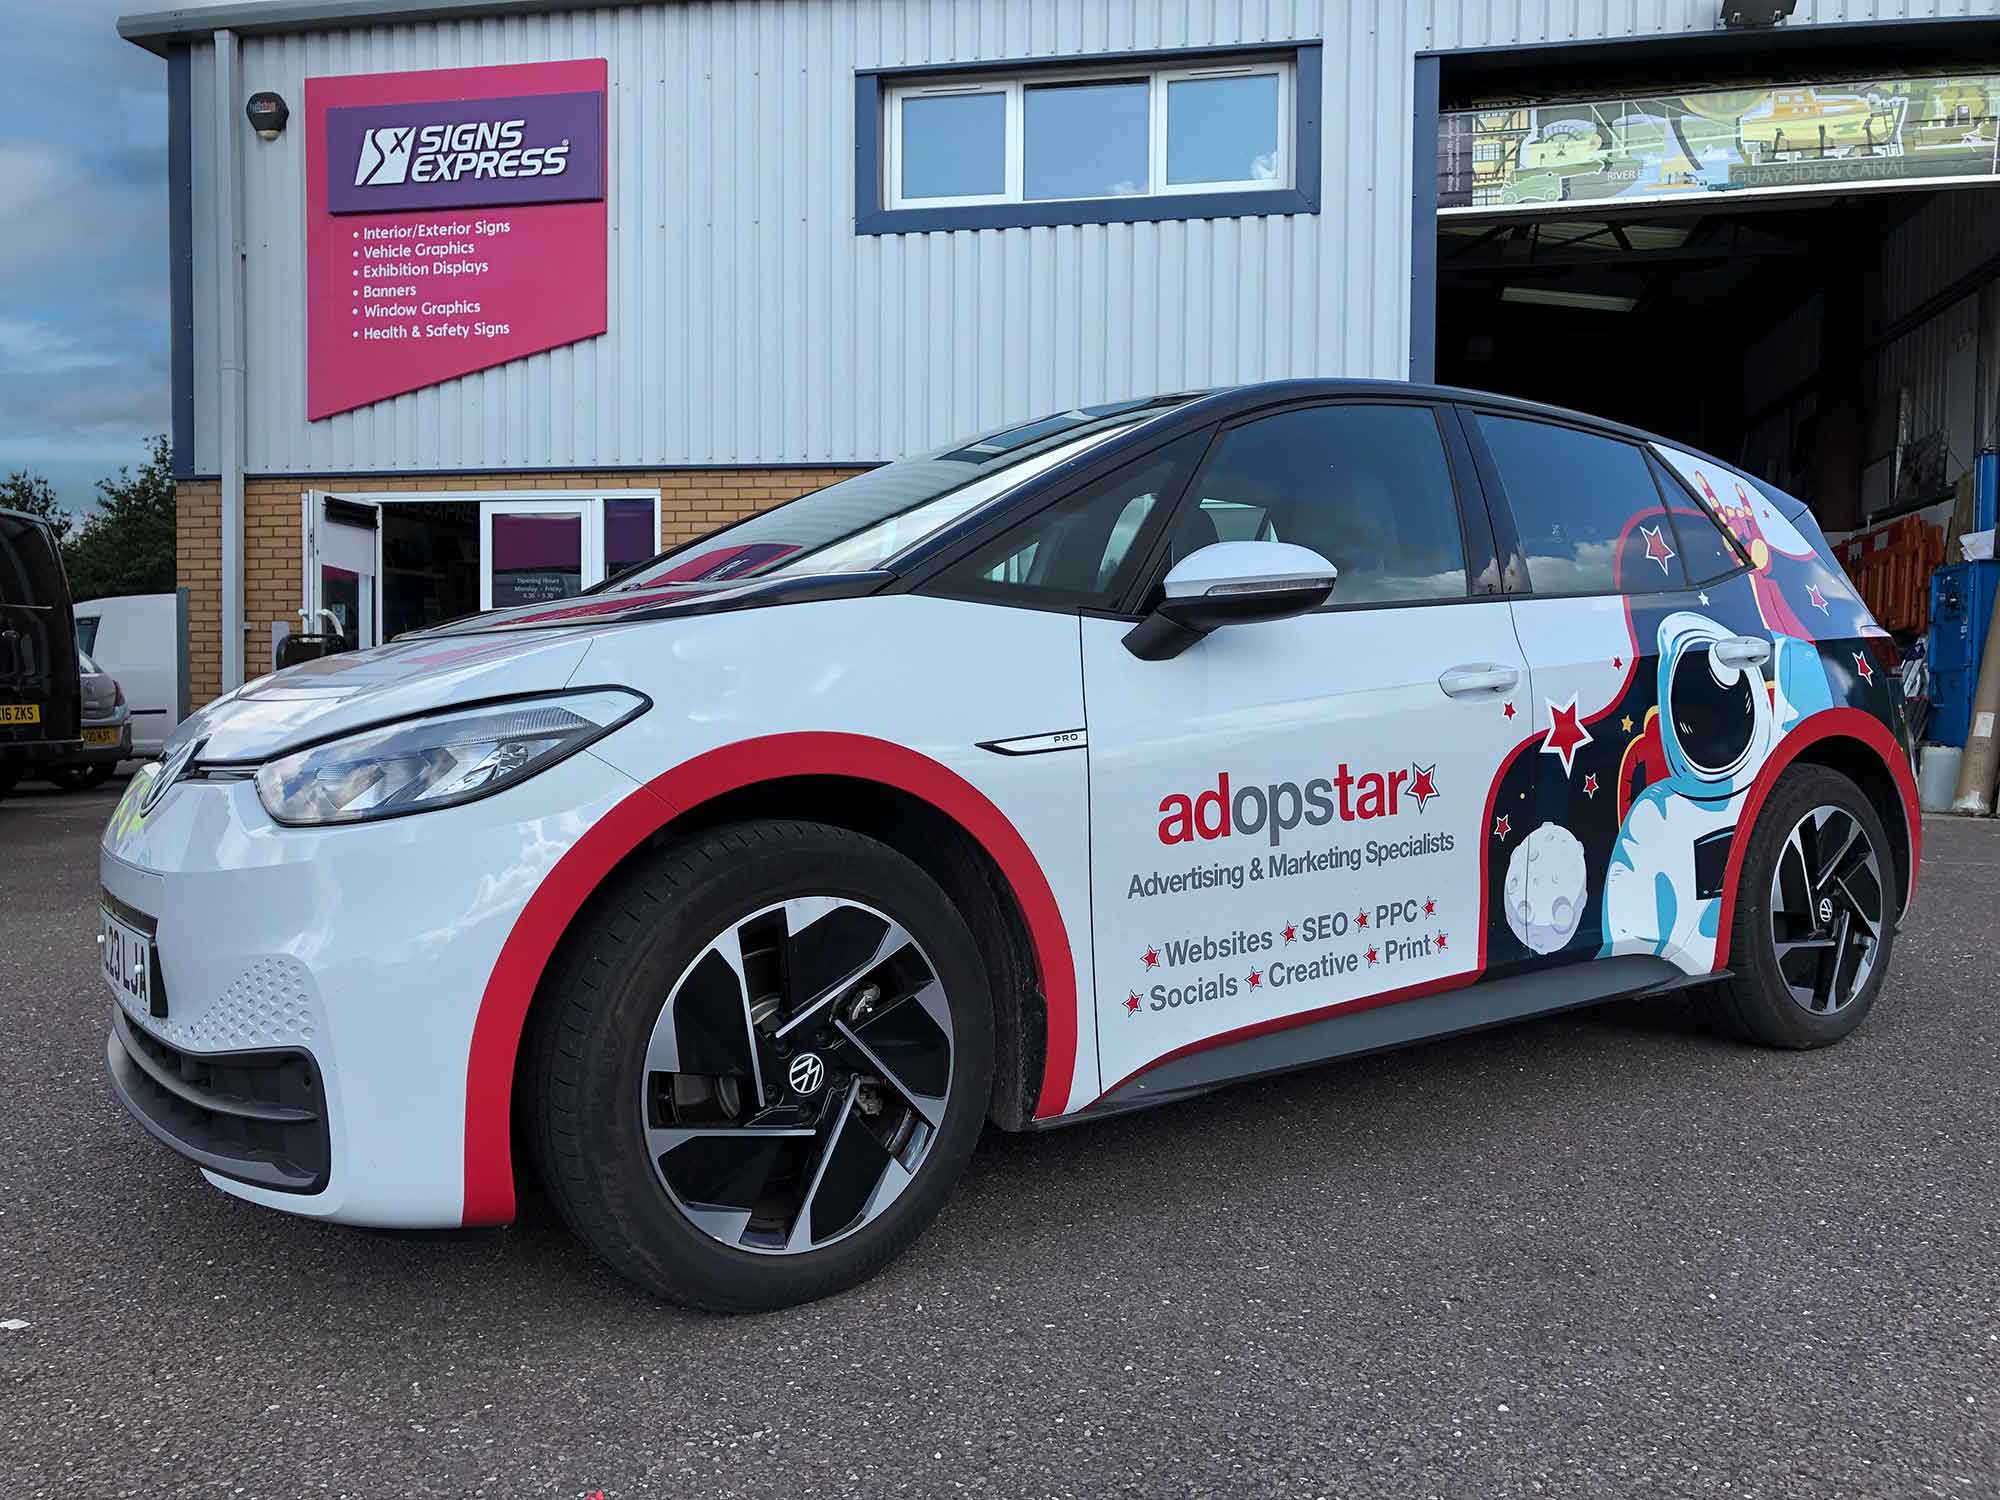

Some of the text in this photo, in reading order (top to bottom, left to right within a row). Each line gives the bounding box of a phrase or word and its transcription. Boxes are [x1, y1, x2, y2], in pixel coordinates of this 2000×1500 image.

[418, 119, 525, 153] SIGNS
[411, 146, 568, 182] EXPRESS
[1828, 164, 1842, 178] &
[1845, 161, 1910, 178] CANAL
[1607, 169, 1636, 181] RIVER
[363, 219, 511, 241] Interior/Exterior Signs
[364, 241, 475, 259] Vehicle Graphics
[363, 260, 489, 279] Exhibition Displays
[363, 284, 417, 299] Banners
[364, 300, 481, 318] Window Graphics
[363, 321, 510, 341] Health & Safety Signs
[0, 706, 34, 721] 16 ZKS
[1053, 733, 1078, 743] PRO
[1158, 763, 1408, 847] adopstar
[1127, 831, 1455, 899] Advertising & Marketing Specialists
[1165, 899, 1418, 967] Websites SEO PPC
[122, 935, 148, 1003] LJA
[1150, 934, 1431, 1012] Socials Creative Print
